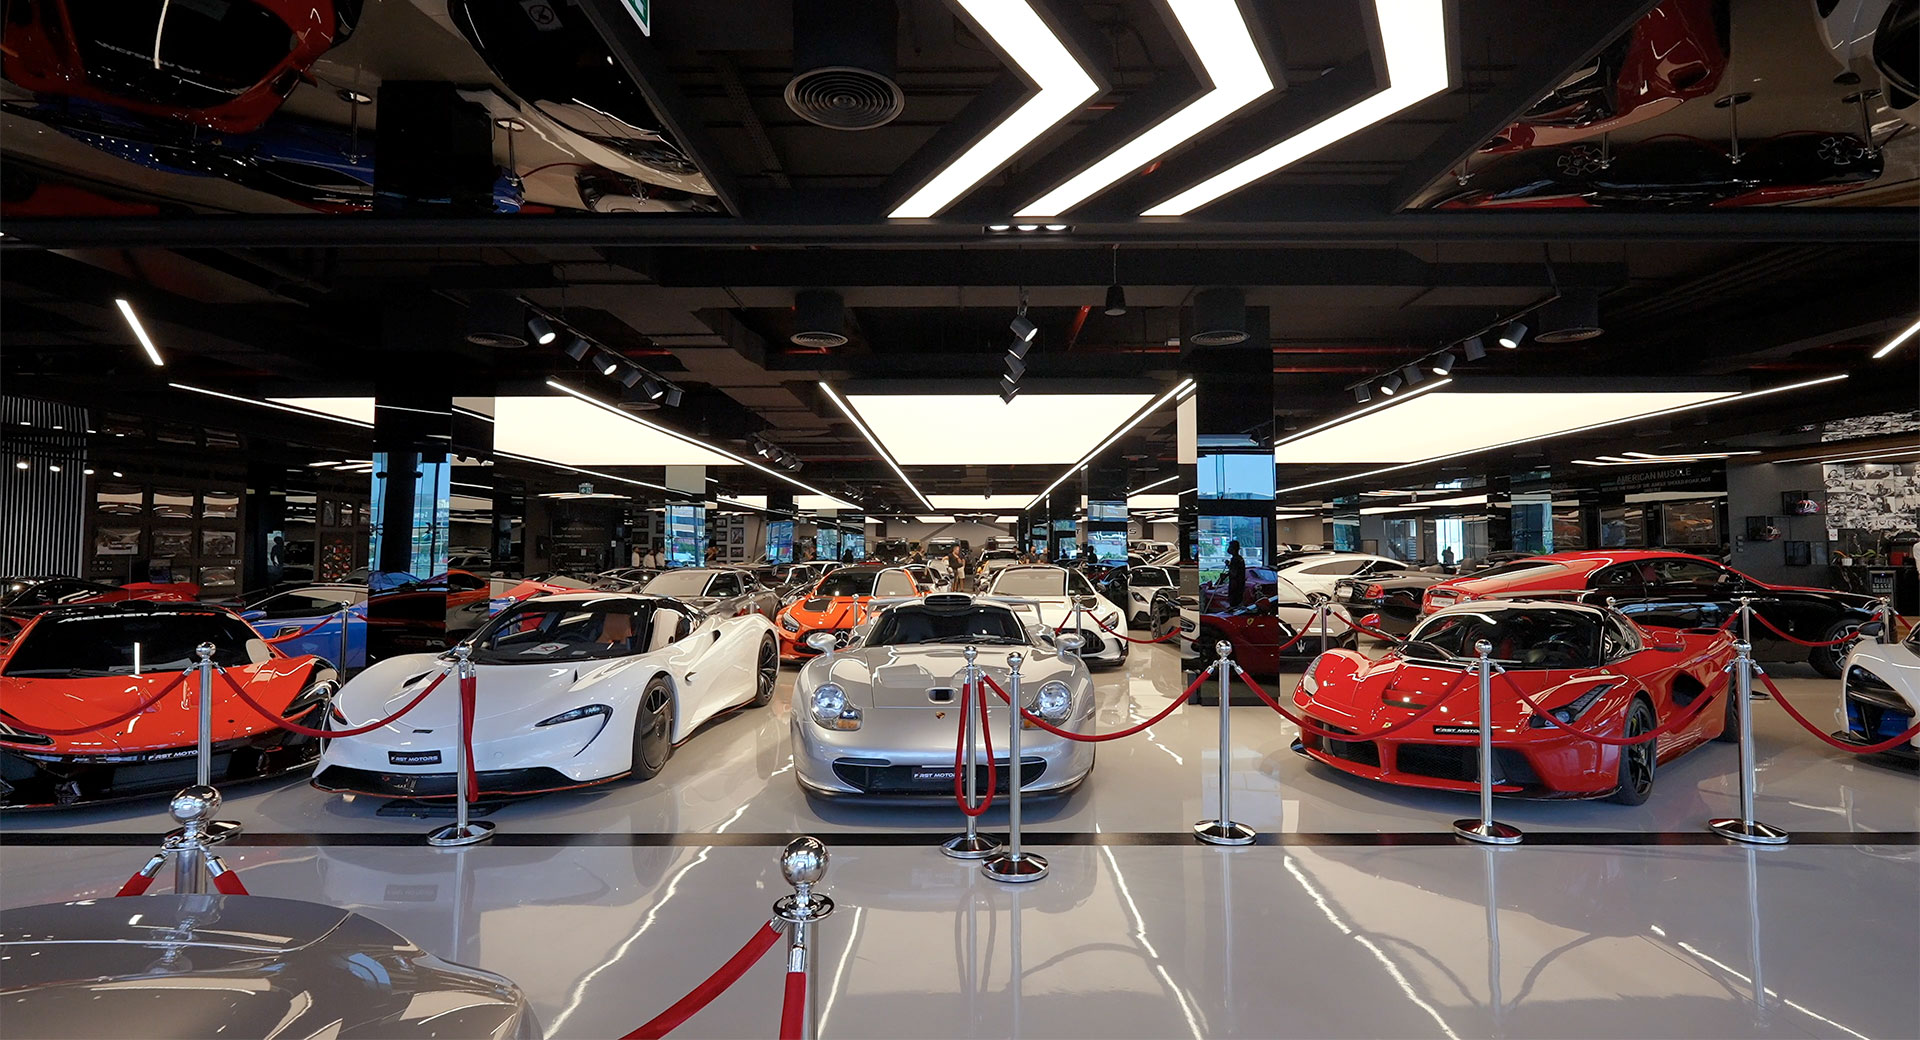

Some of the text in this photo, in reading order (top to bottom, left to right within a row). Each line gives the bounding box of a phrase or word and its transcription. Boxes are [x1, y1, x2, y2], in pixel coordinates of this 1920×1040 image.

[1616, 472, 1657, 485] AMERICAN
[1657, 467, 1691, 480] MUSCLE
[173, 750, 199, 759] MOTO
